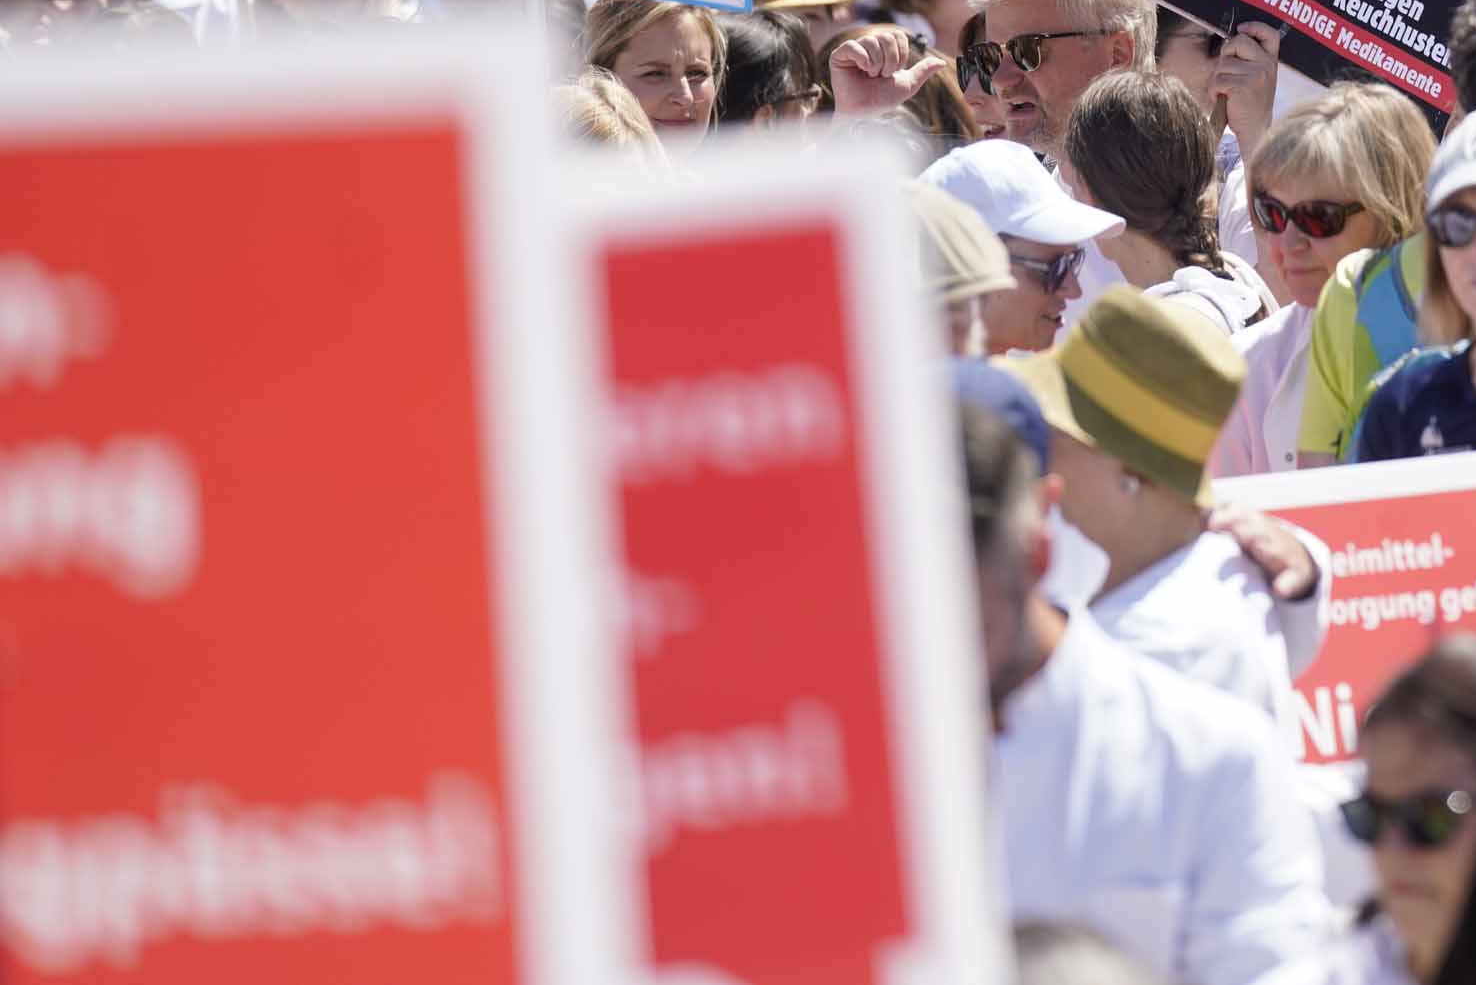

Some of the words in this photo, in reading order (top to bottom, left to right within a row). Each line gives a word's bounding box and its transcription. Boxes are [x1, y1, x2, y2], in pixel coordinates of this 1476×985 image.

[1336, 26, 1442, 98] Medikamente
[1331, 532, 1455, 577] eimittel-
[1330, 589, 1436, 630] orgung
